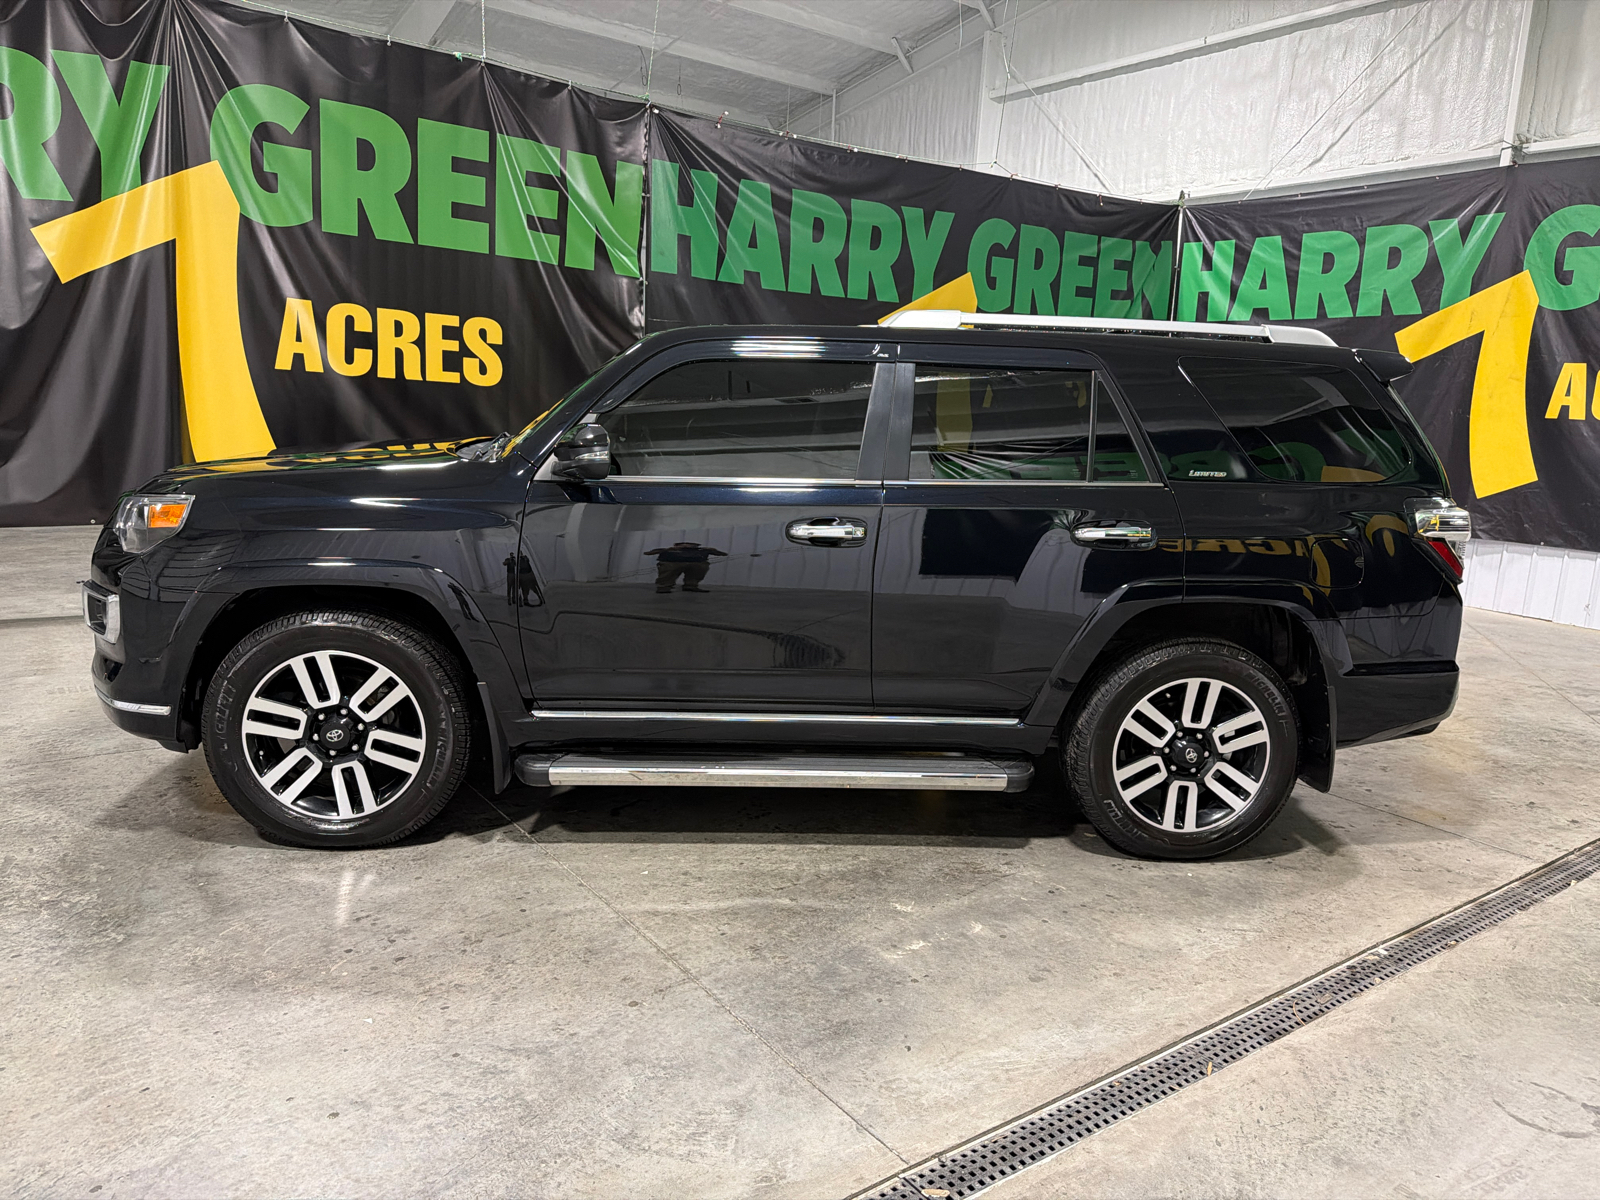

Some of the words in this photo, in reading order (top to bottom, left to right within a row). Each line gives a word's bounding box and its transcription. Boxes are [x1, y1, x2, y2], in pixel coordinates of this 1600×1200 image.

[210, 83, 643, 278] GREEN
[651, 158, 956, 303] HARRY
[966, 218, 1173, 320] GREEN
[1176, 212, 1506, 322] HARRY
[274, 297, 504, 387] ACRES
[1544, 362, 1600, 421] A
